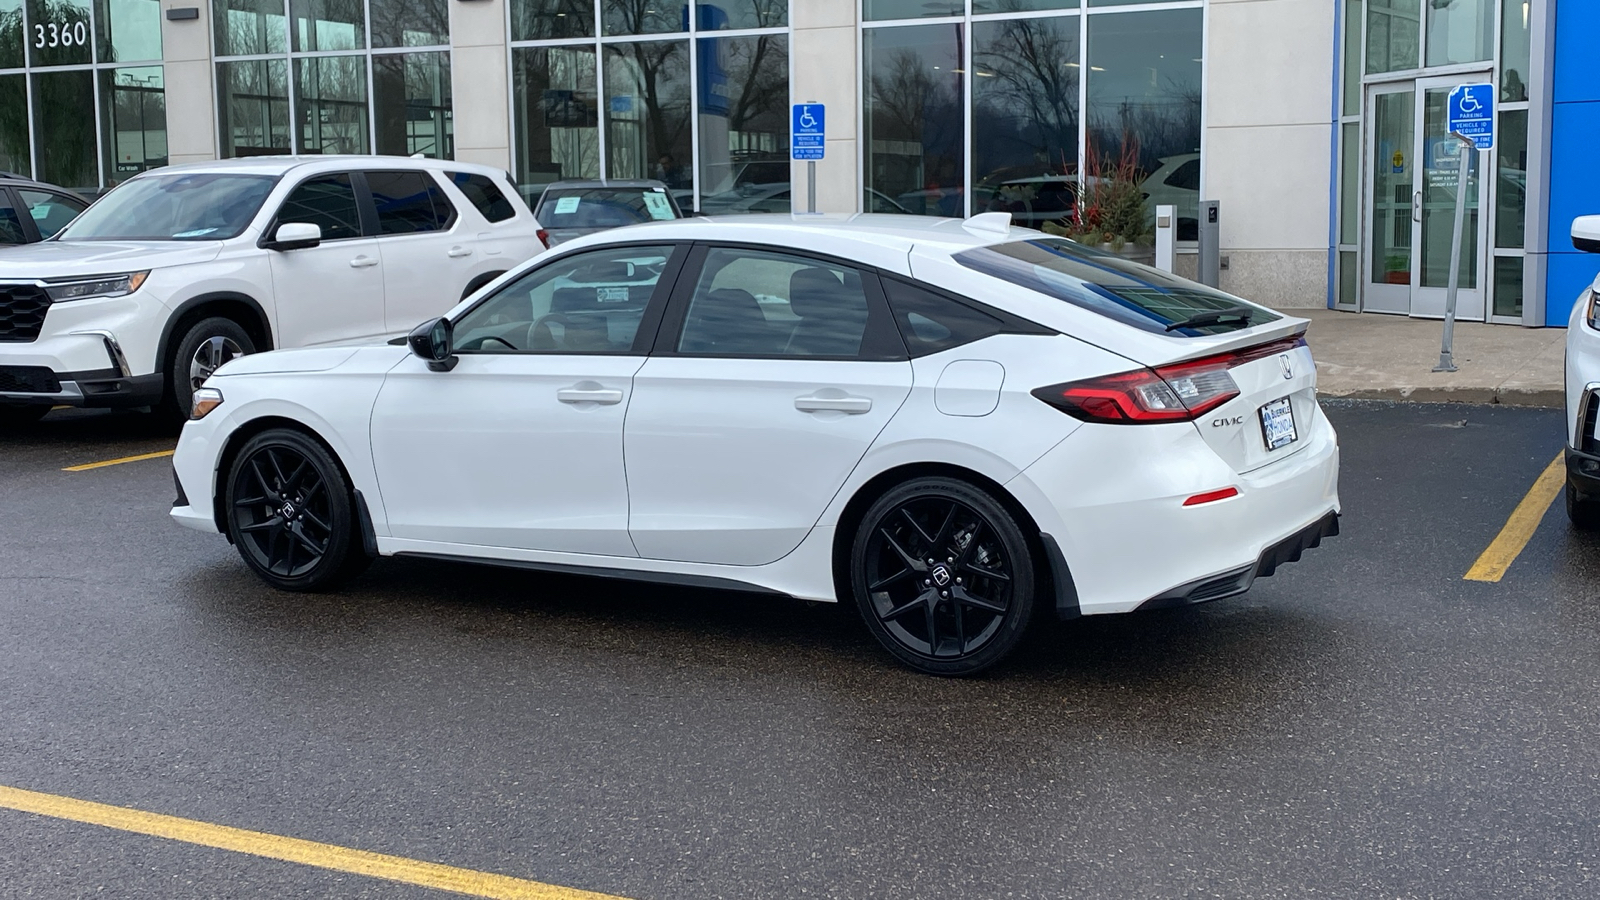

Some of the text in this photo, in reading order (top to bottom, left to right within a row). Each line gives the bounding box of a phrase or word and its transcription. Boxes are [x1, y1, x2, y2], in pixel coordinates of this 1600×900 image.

[34, 21, 86, 48] 3360
[1212, 415, 1243, 428] CIVIC
[1272, 418, 1292, 434] HONDA
